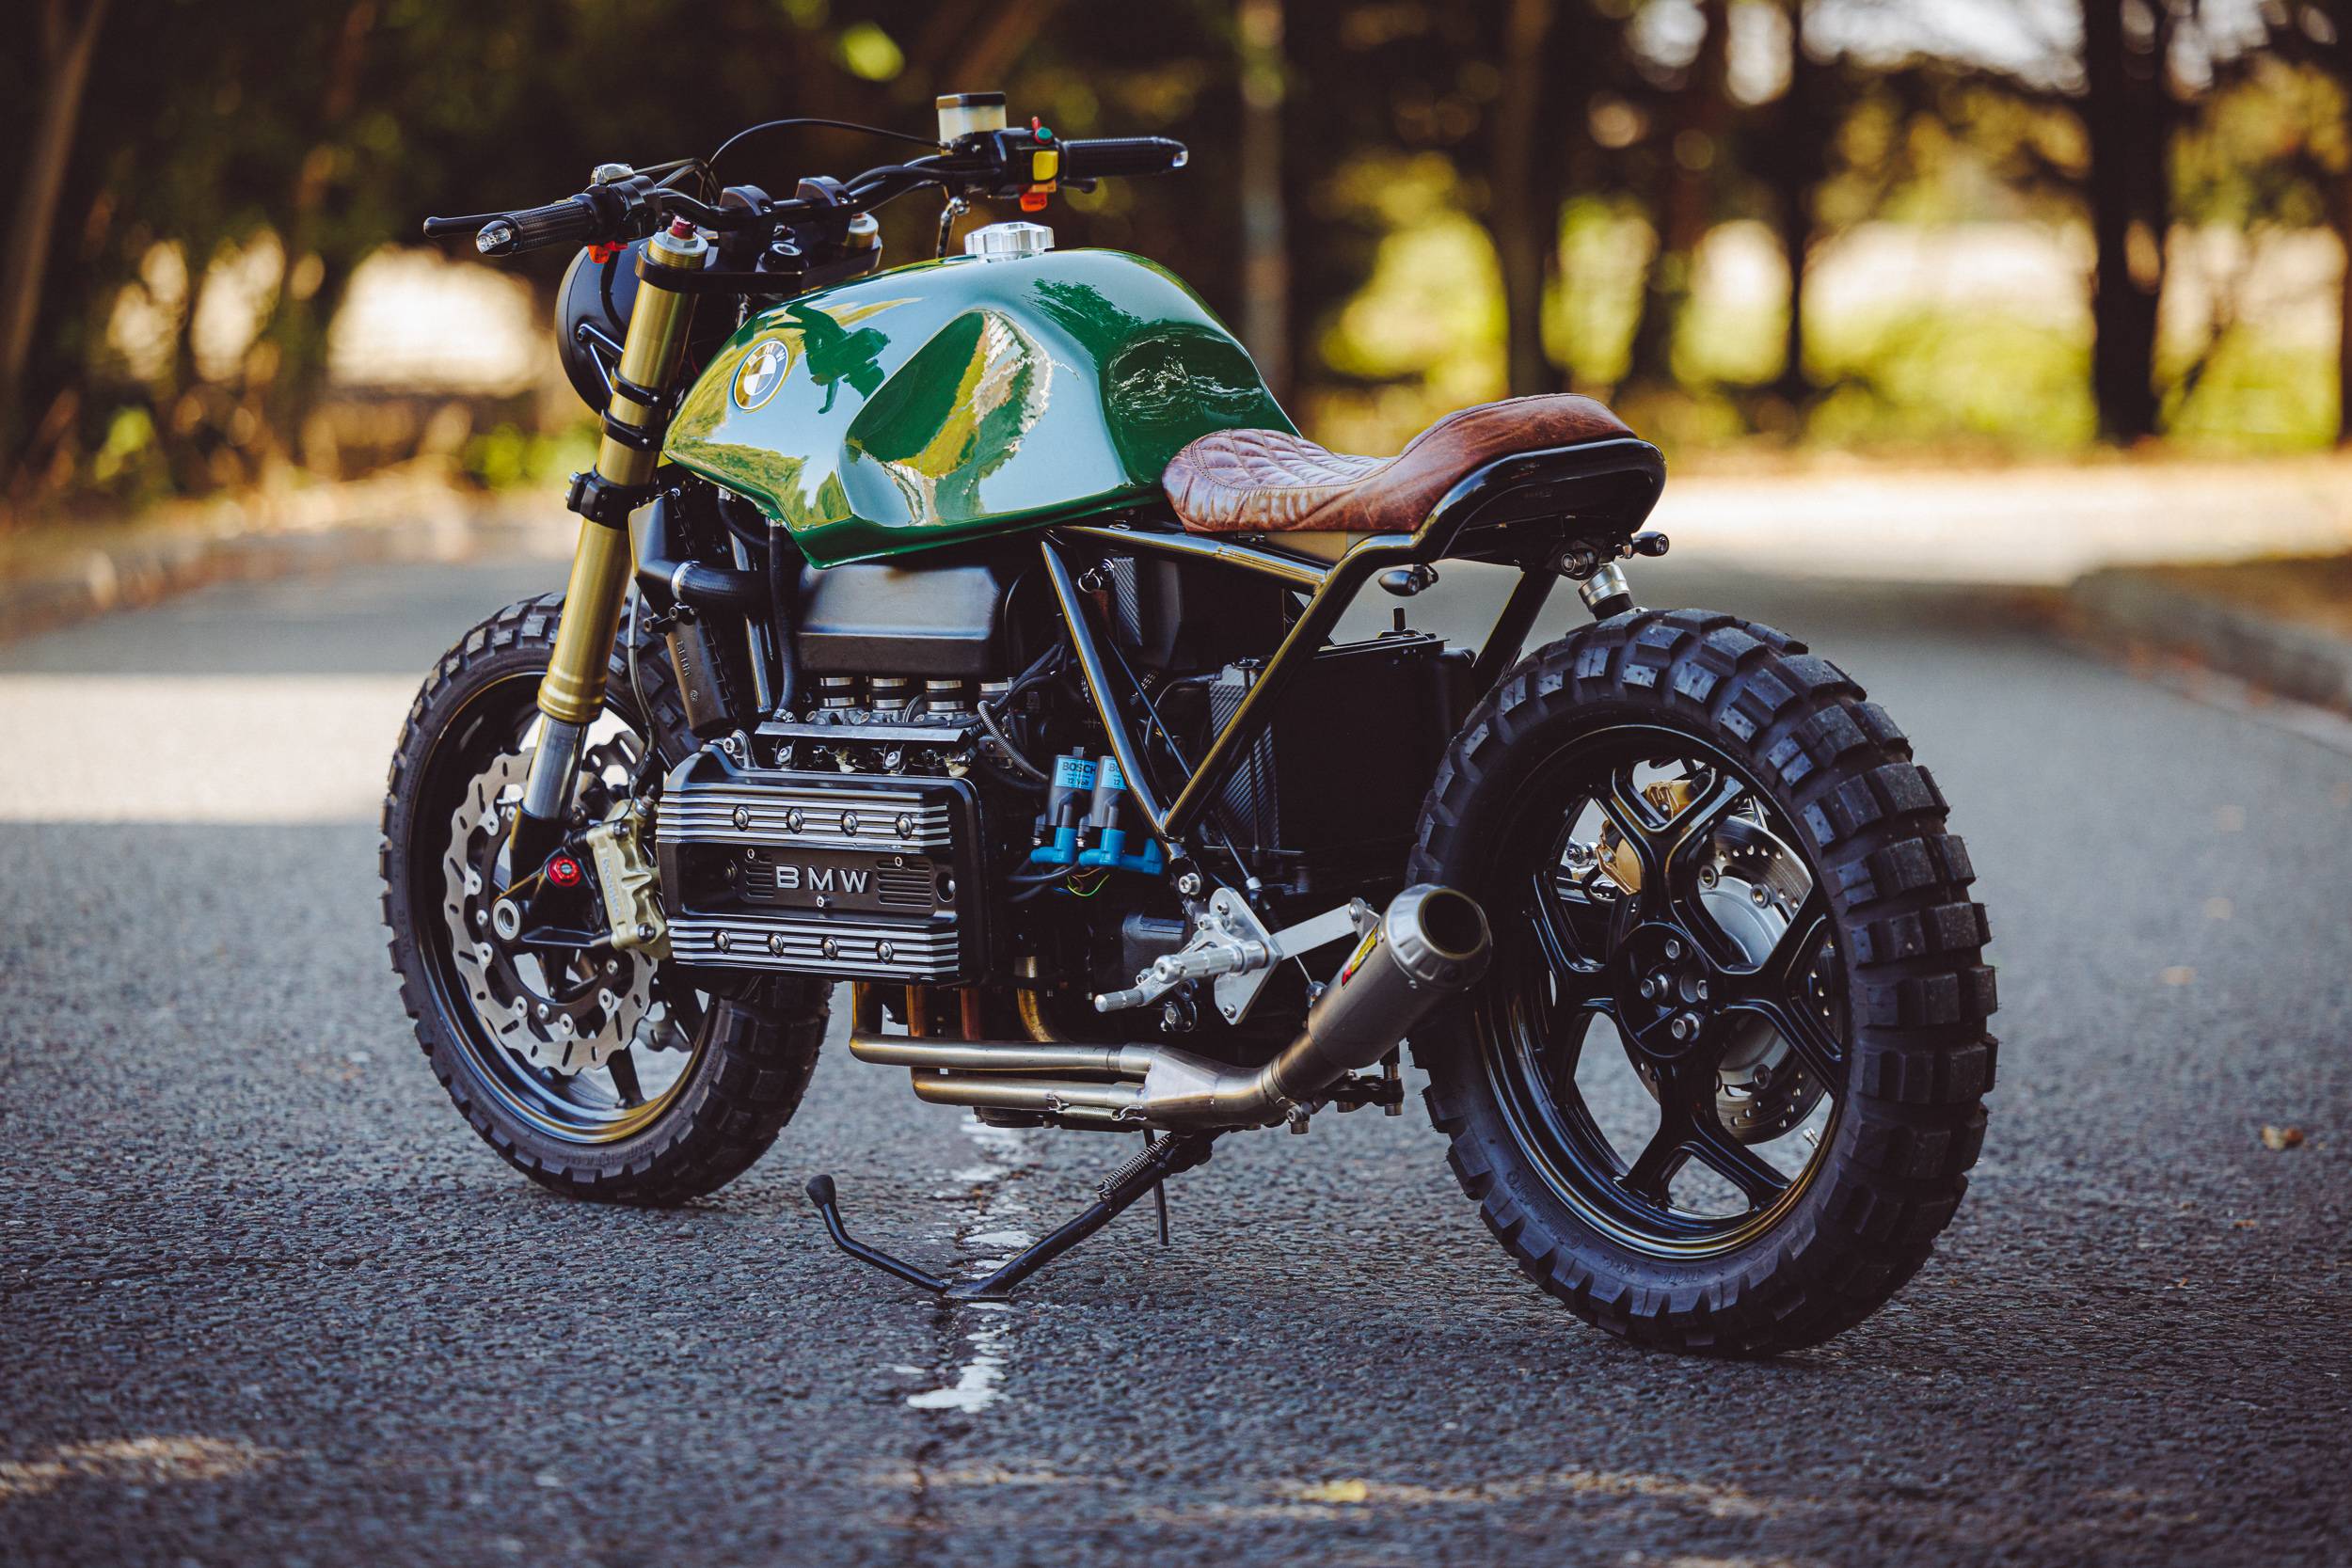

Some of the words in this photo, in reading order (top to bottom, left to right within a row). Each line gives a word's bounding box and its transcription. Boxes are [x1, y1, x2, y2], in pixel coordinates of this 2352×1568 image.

[748, 343, 786, 366] BMW
[1062, 762, 1097, 775] BOSCH
[776, 865, 867, 894] BMW
